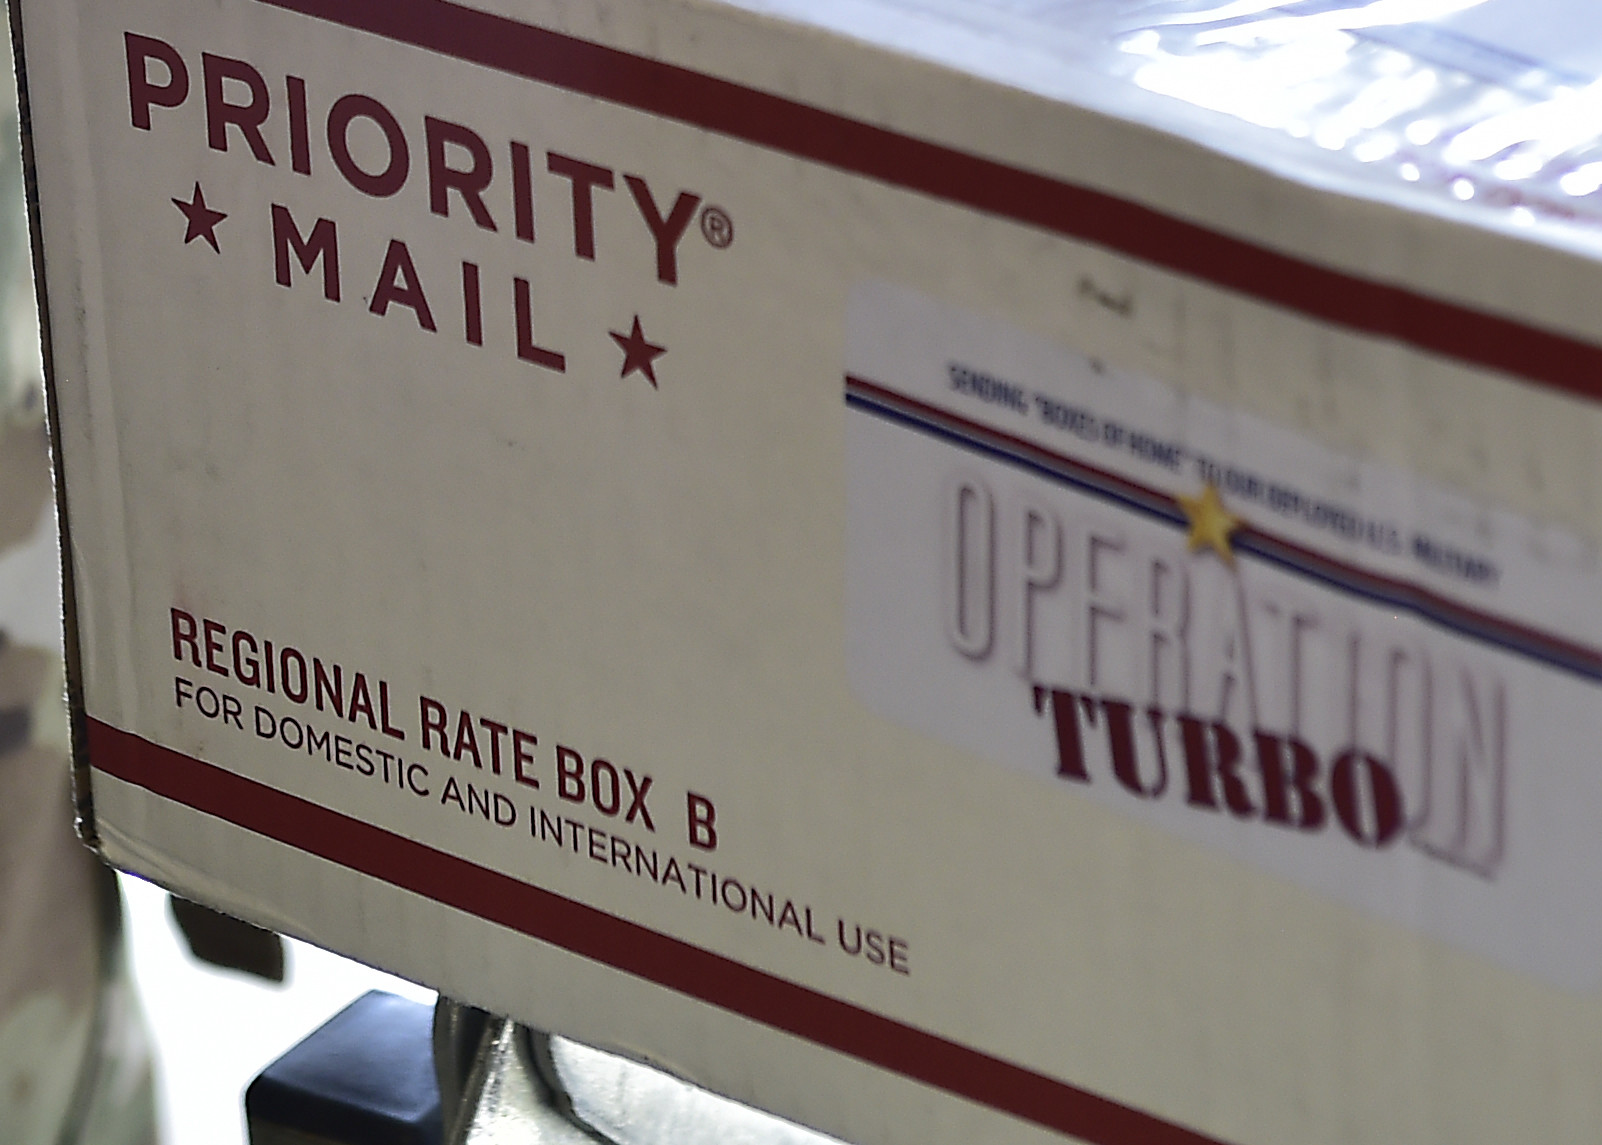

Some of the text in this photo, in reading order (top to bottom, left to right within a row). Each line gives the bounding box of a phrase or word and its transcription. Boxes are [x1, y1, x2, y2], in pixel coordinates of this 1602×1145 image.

[270, 202, 567, 374] MAIL
[170, 607, 719, 852] REGIONAL RATE BOX B
[948, 468, 1510, 879] OPERATION
[1033, 683, 1404, 851] TURBO
[174, 677, 912, 976] FOR DOMESTIC AND INTERNATIONAL USE
